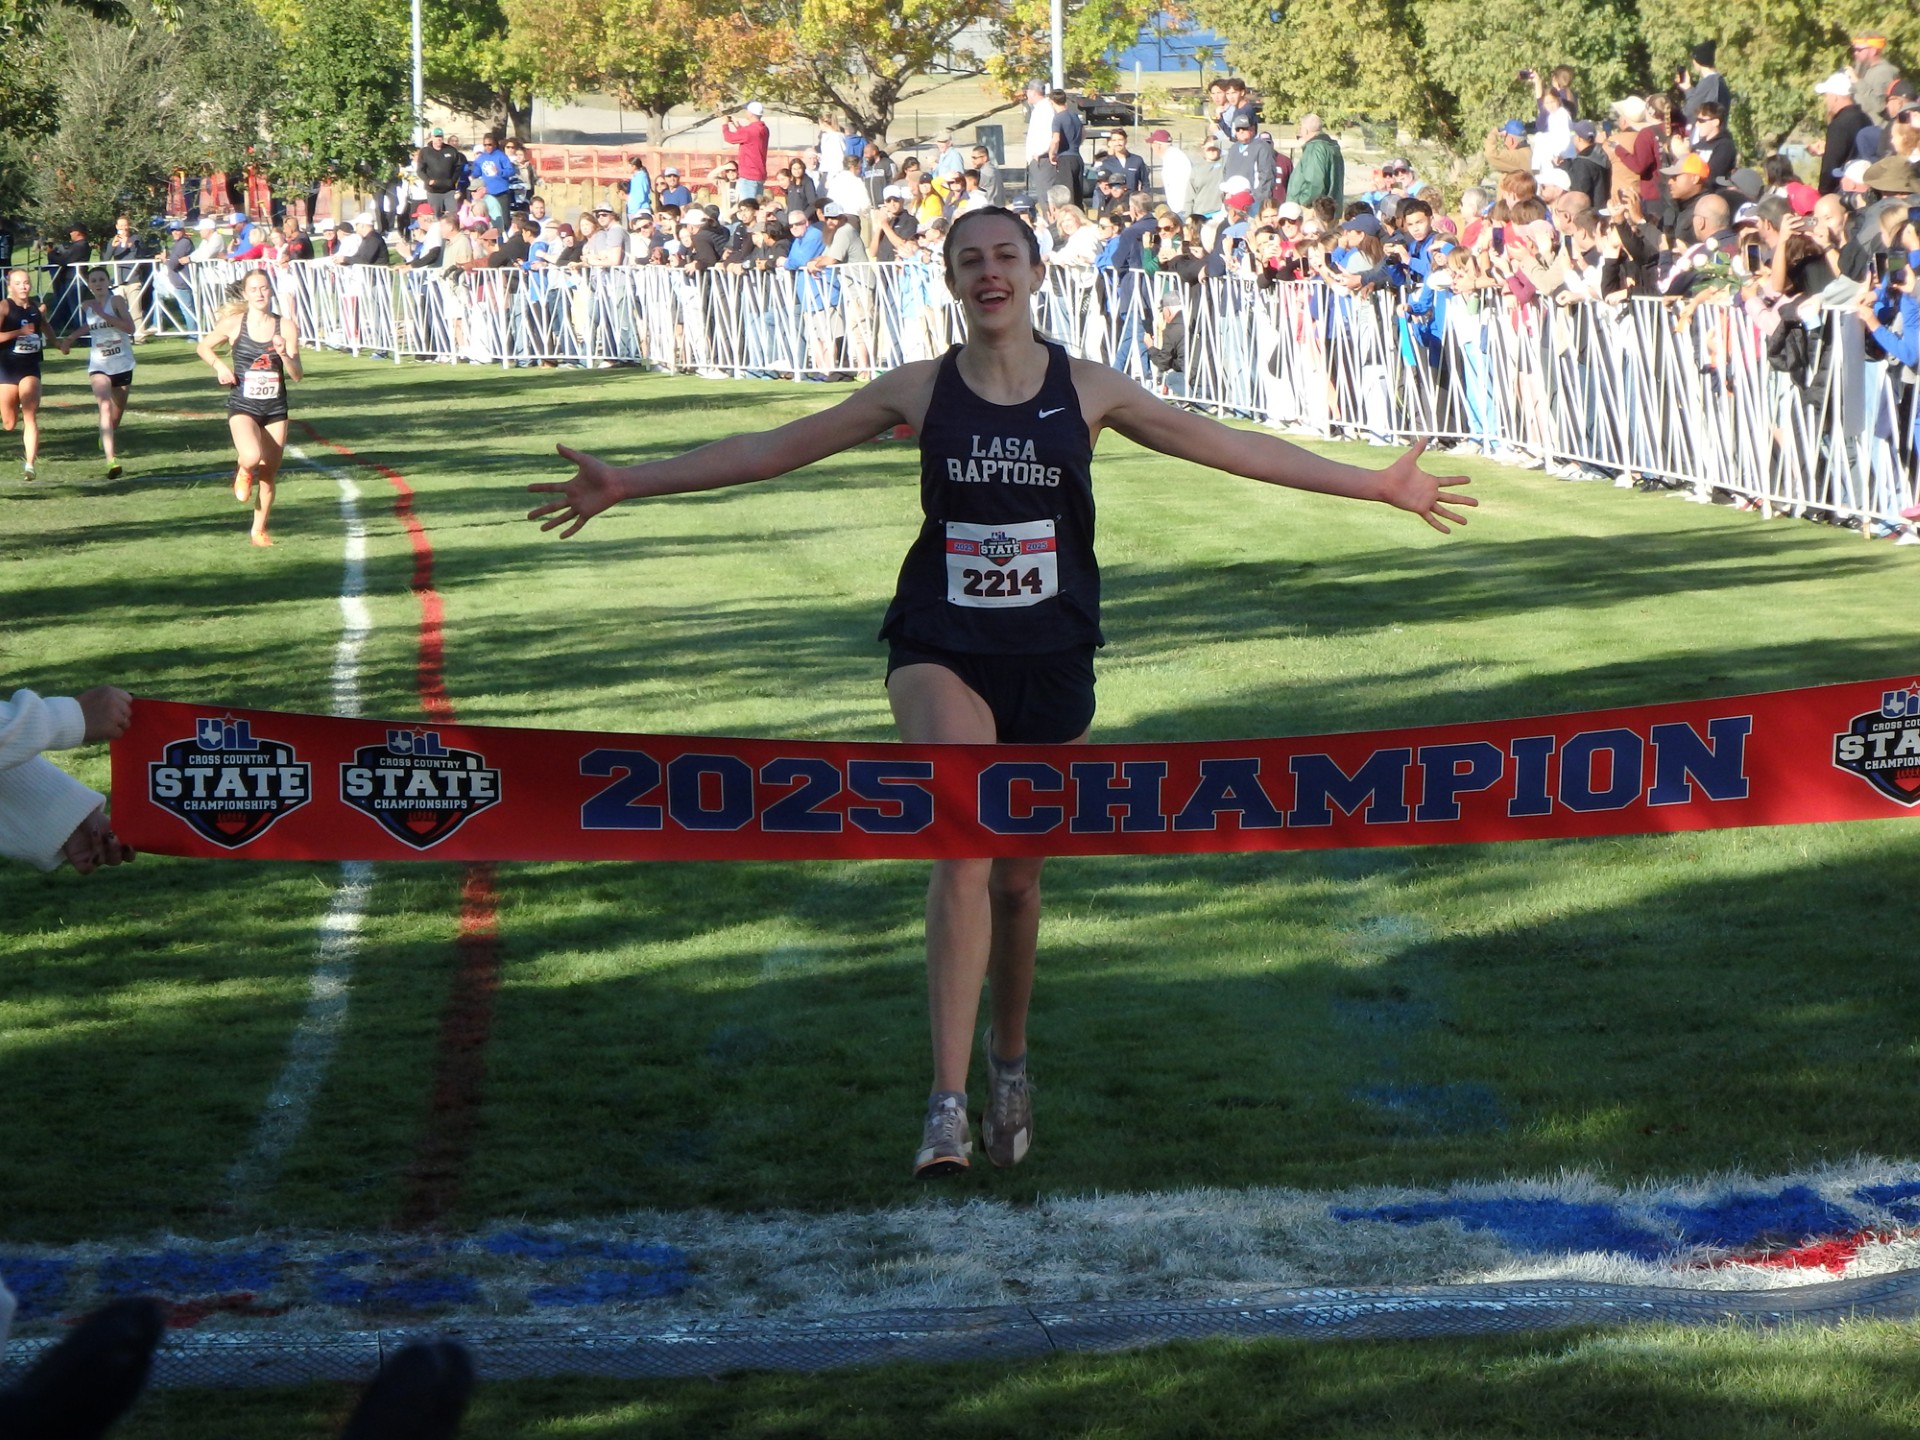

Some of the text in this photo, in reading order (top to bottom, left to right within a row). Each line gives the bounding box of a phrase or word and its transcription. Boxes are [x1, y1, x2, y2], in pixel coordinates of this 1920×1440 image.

[101, 346, 121, 357] 2310
[249, 386, 276, 396] 2207
[971, 435, 1037, 462] LASA
[946, 458, 1062, 488] RAPTORS
[954, 543, 974, 552] 2025
[980, 543, 1020, 555] STATE
[1026, 542, 1048, 551] 2025
[962, 567, 1043, 598] 2214
[1872, 720, 1903, 732] CROSS
[1839, 728, 1920, 761] STA
[189, 754, 270, 765] CROSS COUNTRY
[379, 757, 461, 769] CROSS COUNTRY
[1864, 757, 1920, 770] CHAMPION
[579, 715, 1753, 834] 2025 CHAMPION
[155, 767, 305, 798] STATE
[346, 768, 495, 797] STATE
[183, 800, 278, 811] CHAMPIONSHIPS
[374, 799, 468, 810] CHAMPIONSHIPS
